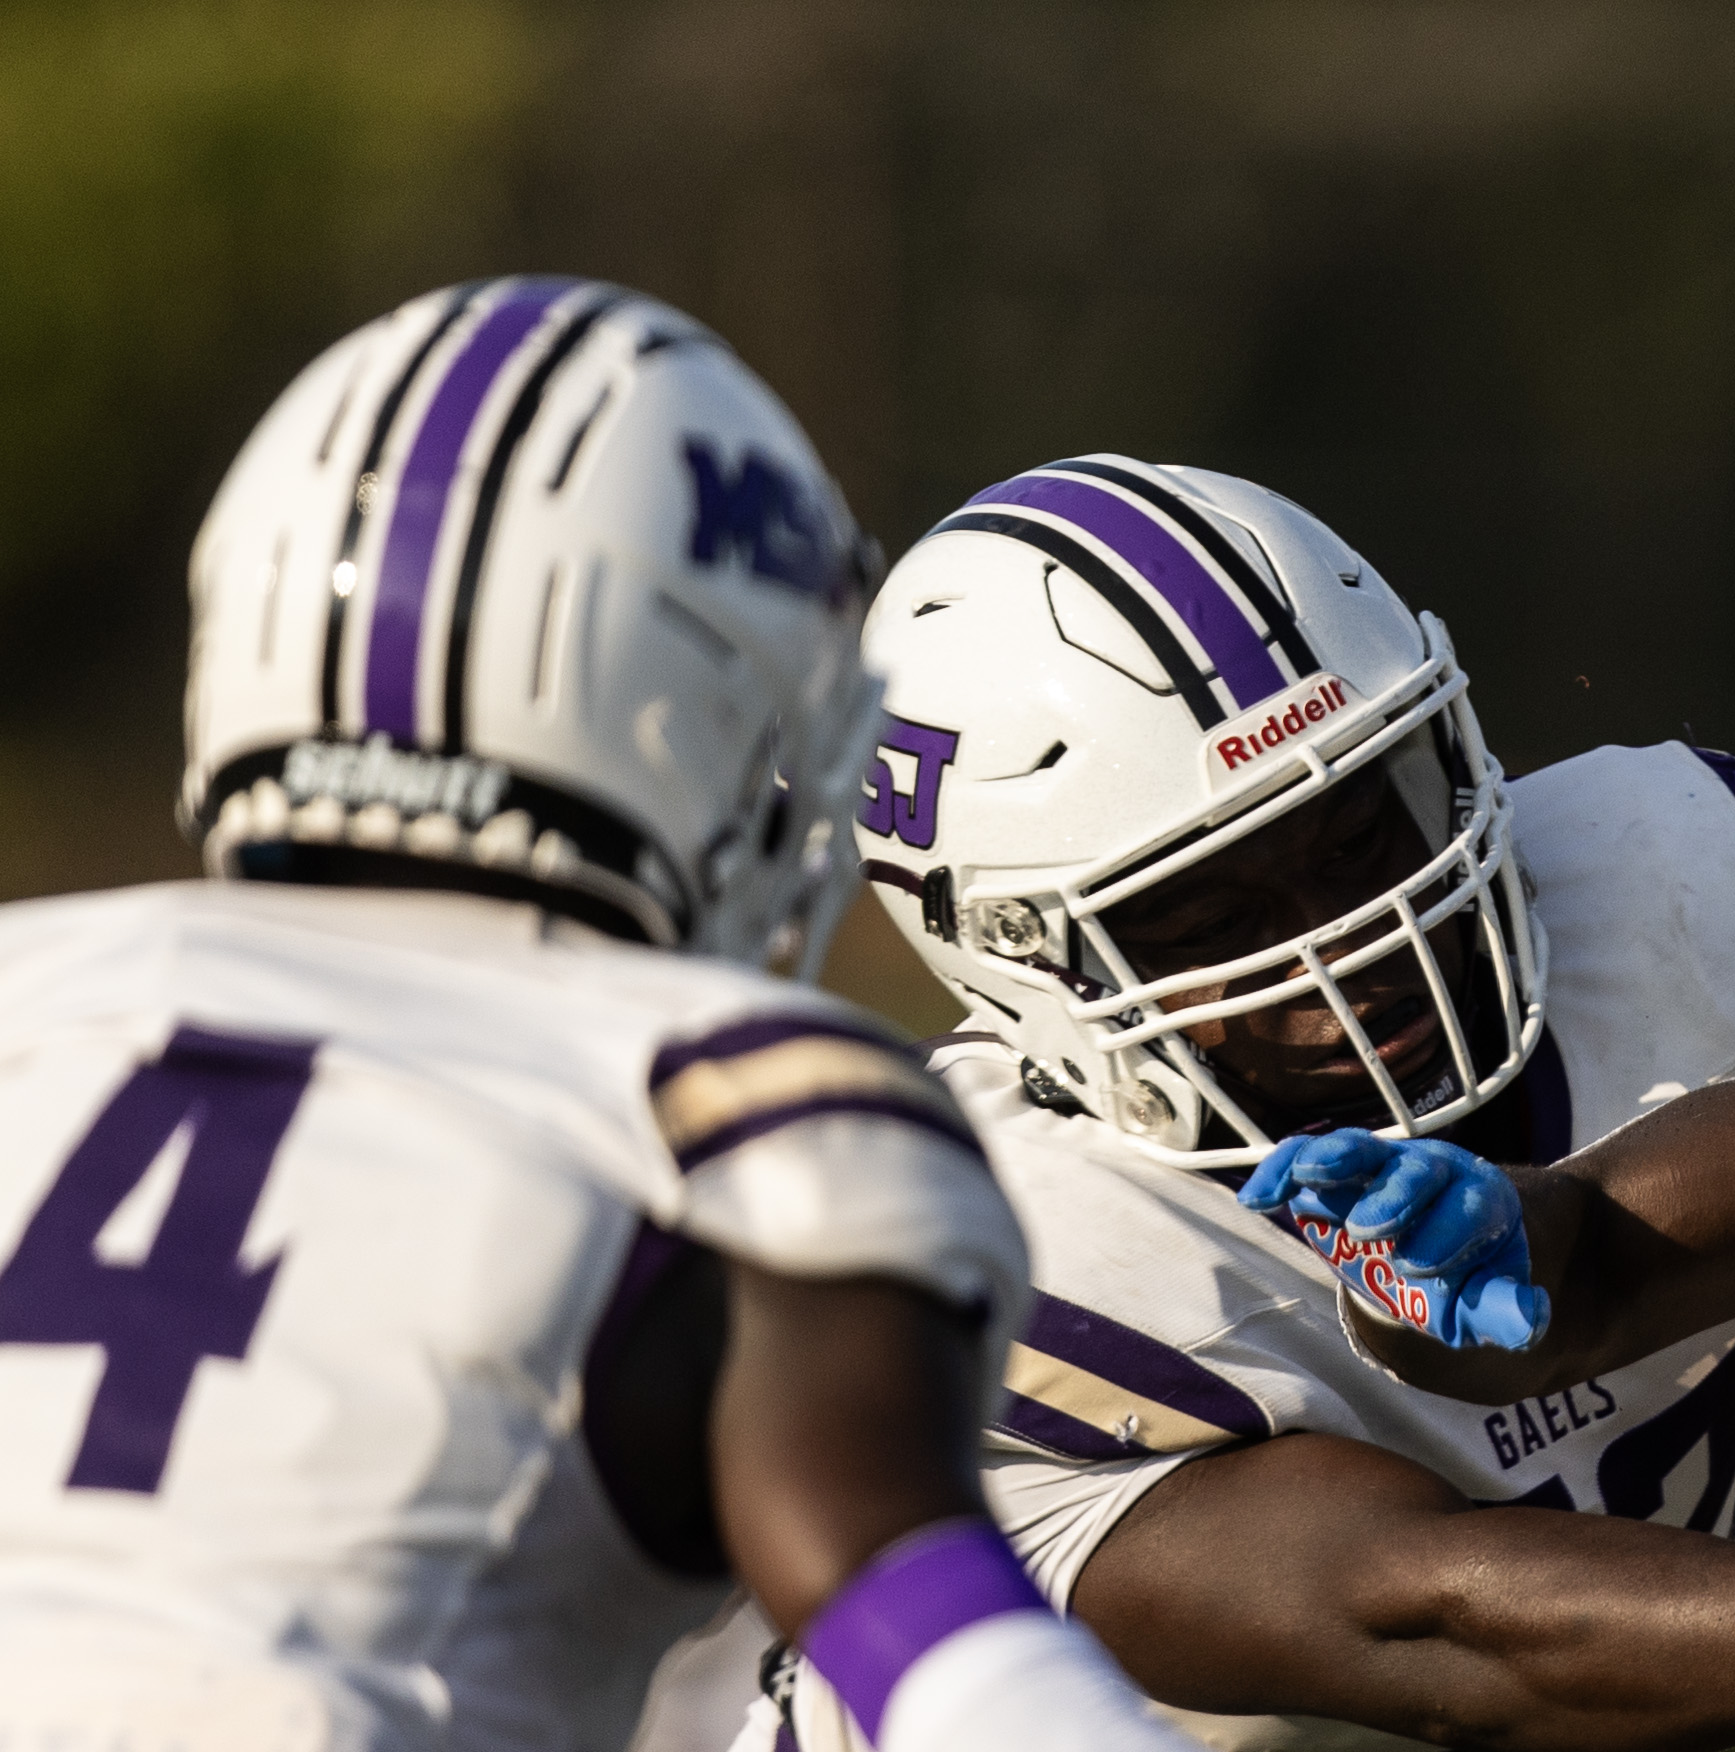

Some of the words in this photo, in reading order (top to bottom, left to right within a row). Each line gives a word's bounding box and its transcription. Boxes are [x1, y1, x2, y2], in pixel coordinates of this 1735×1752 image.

[1216, 679, 1348, 771] Riddell
[1412, 1075, 1455, 1116] ddell
[0, 1018, 328, 1500] 4
[1483, 1379, 1618, 1471] GAELS
